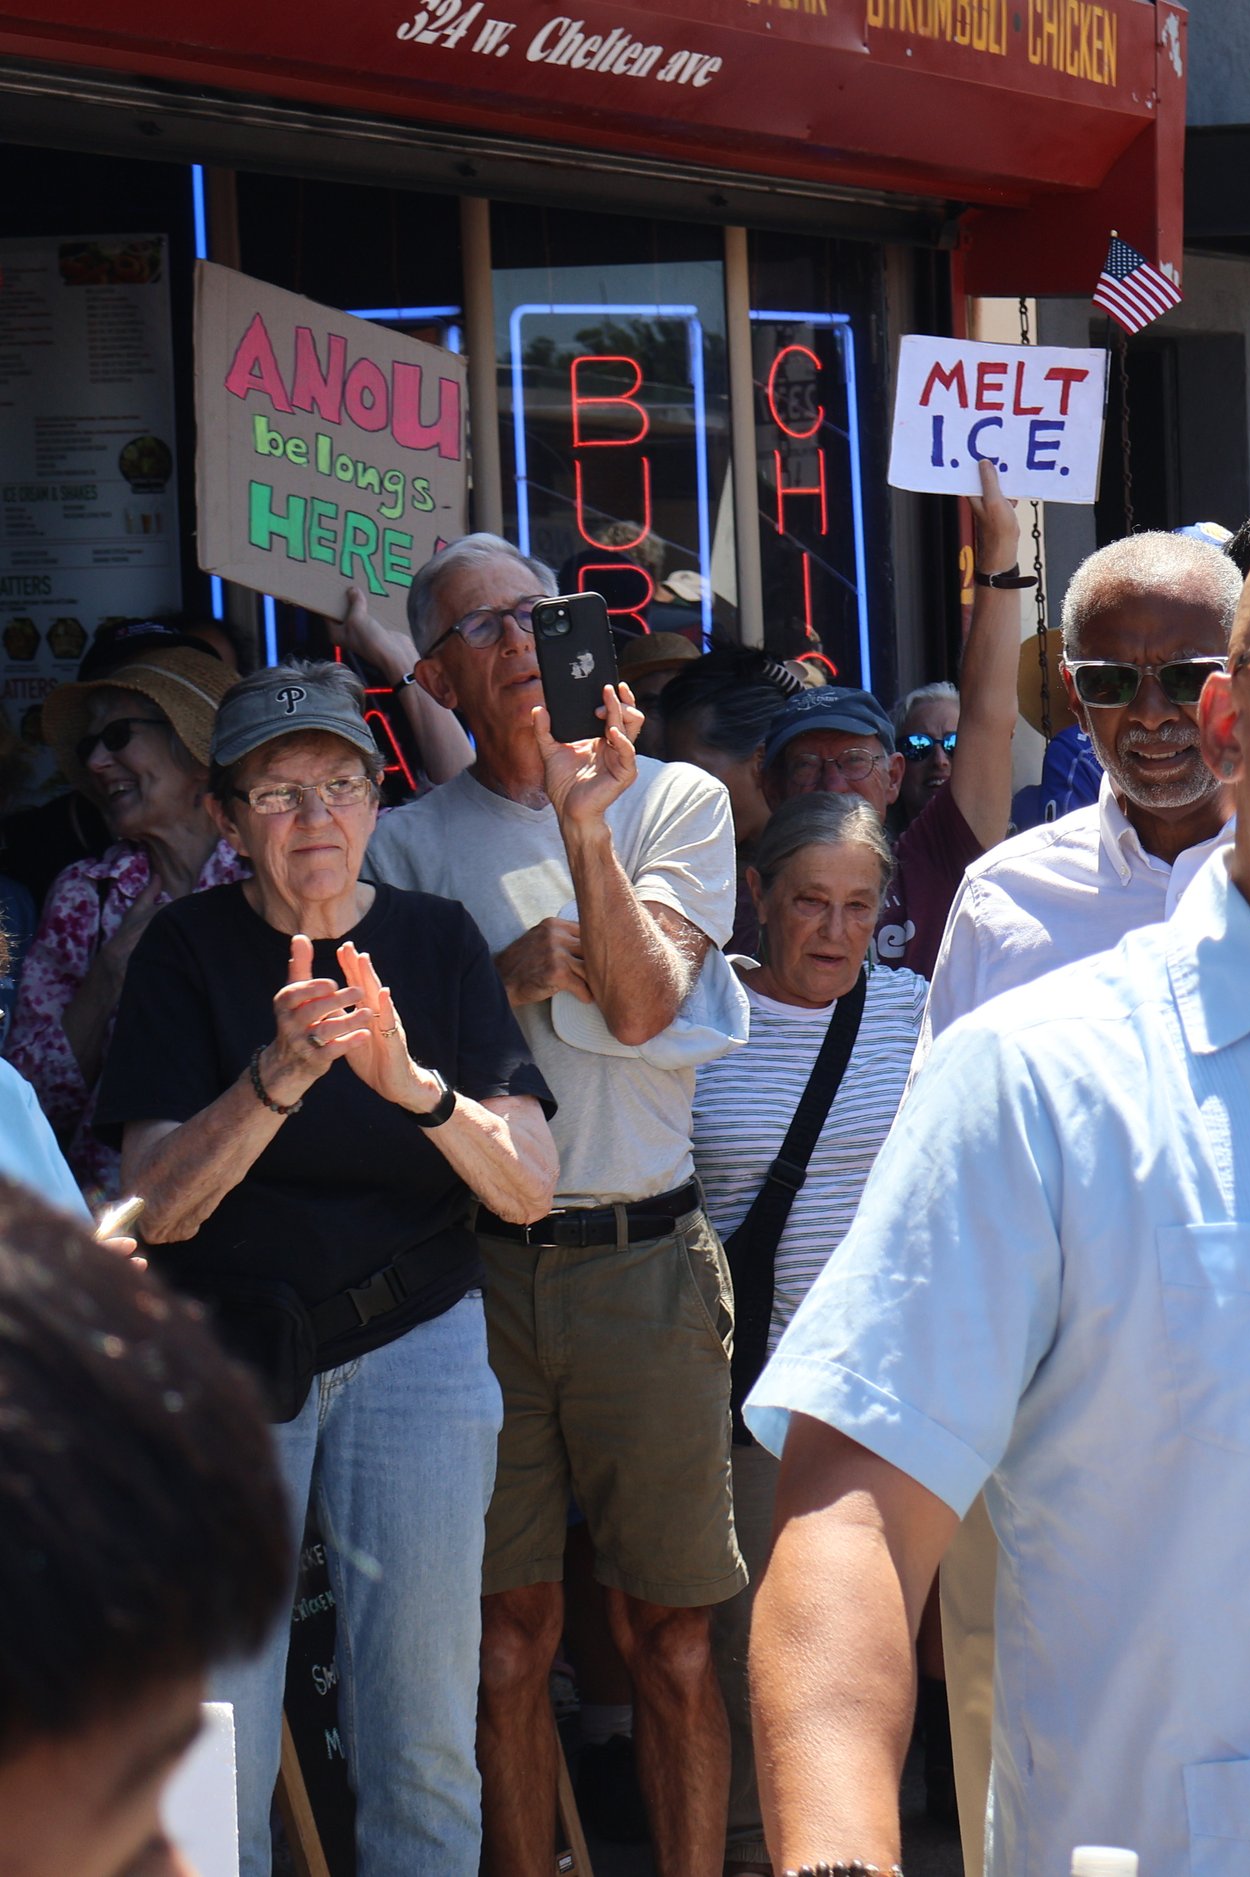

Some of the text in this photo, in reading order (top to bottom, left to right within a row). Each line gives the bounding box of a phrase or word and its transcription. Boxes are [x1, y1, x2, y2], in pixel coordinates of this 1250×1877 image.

[396, 0, 485, 49] 324
[525, 16, 664, 78] Chelten
[656, 49, 723, 88] ave
[1028, 0, 1117, 87] CHICKEN
[225, 312, 461, 461] ANOU
[918, 360, 1090, 416] MELT
[252, 413, 436, 519] belongs
[931, 415, 1070, 476] I.C.E.
[249, 480, 415, 597] HERE
